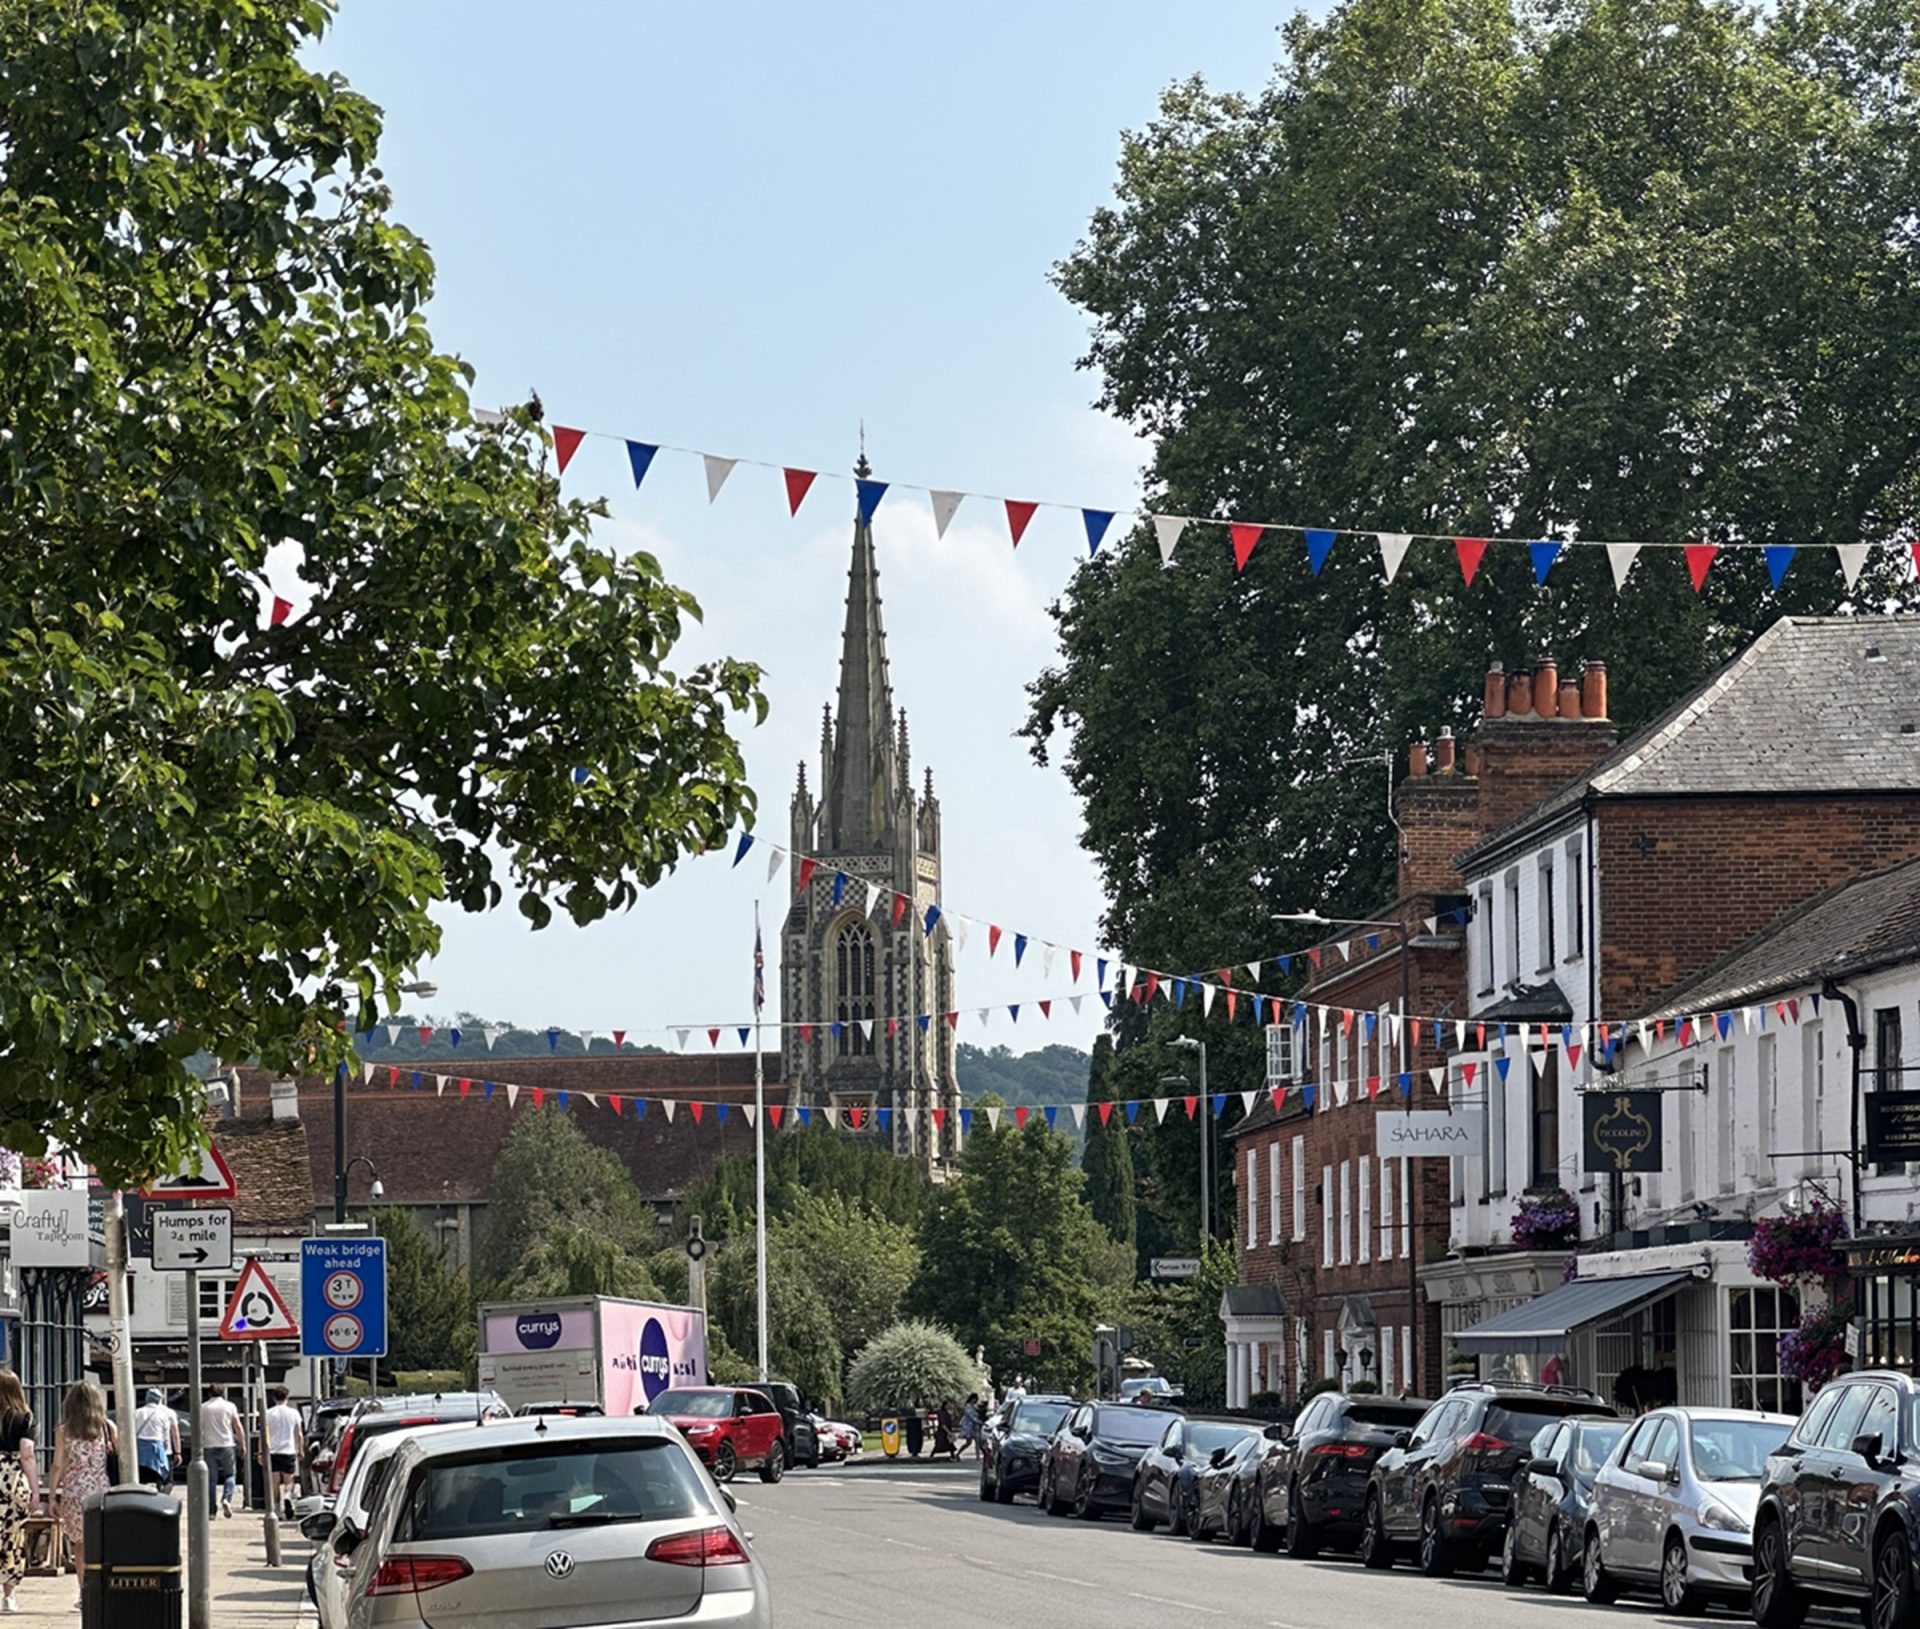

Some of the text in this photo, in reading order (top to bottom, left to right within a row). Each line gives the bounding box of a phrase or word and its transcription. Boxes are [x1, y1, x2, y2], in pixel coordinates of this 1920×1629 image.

[1390, 1126, 1469, 1142] SAHARA
[1599, 1129, 1647, 1137] PICCOLINO
[159, 1214, 228, 1228] Humps for
[188, 1230, 217, 1242] mile
[304, 1244, 381, 1257] Weak bridge
[323, 1257, 361, 1269] ahead
[518, 1321, 560, 1336] currys
[641, 1354, 669, 1380] currys
[110, 1578, 158, 1588] LITTER
